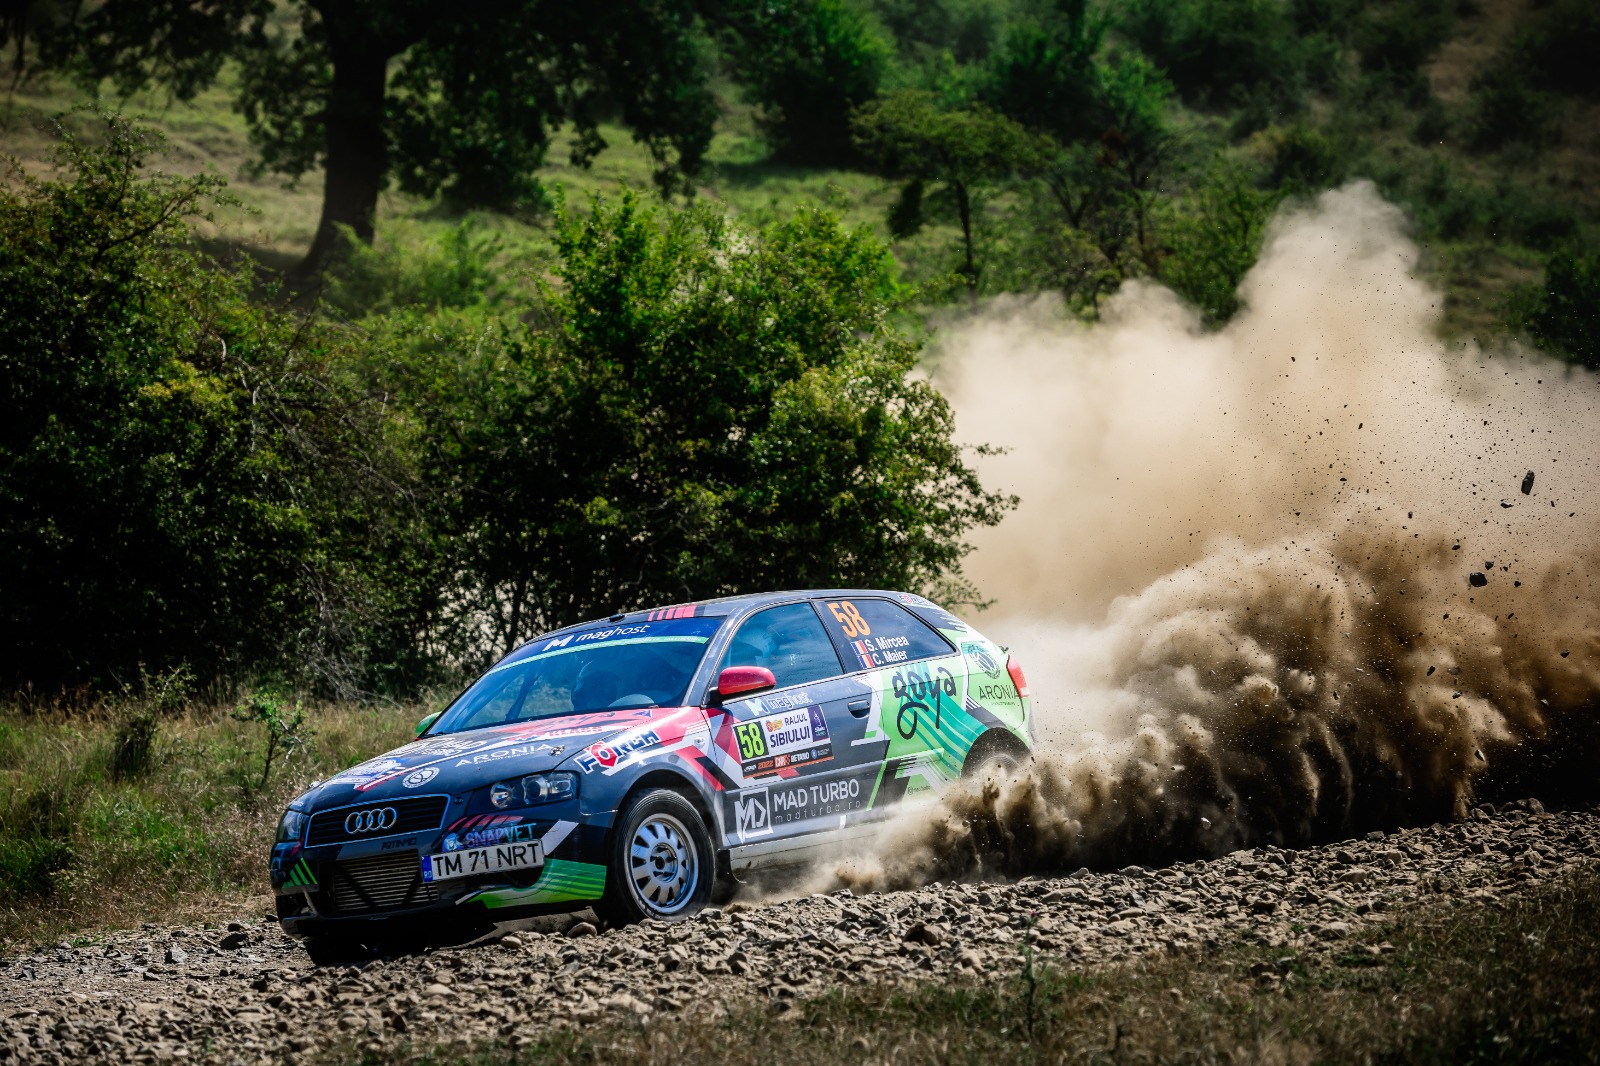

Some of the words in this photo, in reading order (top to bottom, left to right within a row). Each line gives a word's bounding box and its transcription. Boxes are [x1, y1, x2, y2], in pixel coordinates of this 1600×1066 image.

[827, 600, 871, 638] 58
[575, 624, 651, 642] maghost
[866, 640, 877, 652] S.
[877, 635, 910, 650] Mircea
[872, 653, 885, 665] C.
[884, 649, 908, 662] Maier
[736, 722, 765, 759] 58
[769, 725, 811, 748] SIBIULUI
[455, 743, 553, 768] ARONIA
[757, 760, 774, 770] 2022
[773, 788, 808, 812] MAD
[809, 779, 860, 805] TURBO
[465, 822, 537, 848] SNAPVET
[432, 855, 463, 877] TM
[468, 850, 489, 872] 71
[496, 843, 539, 867] NRT
